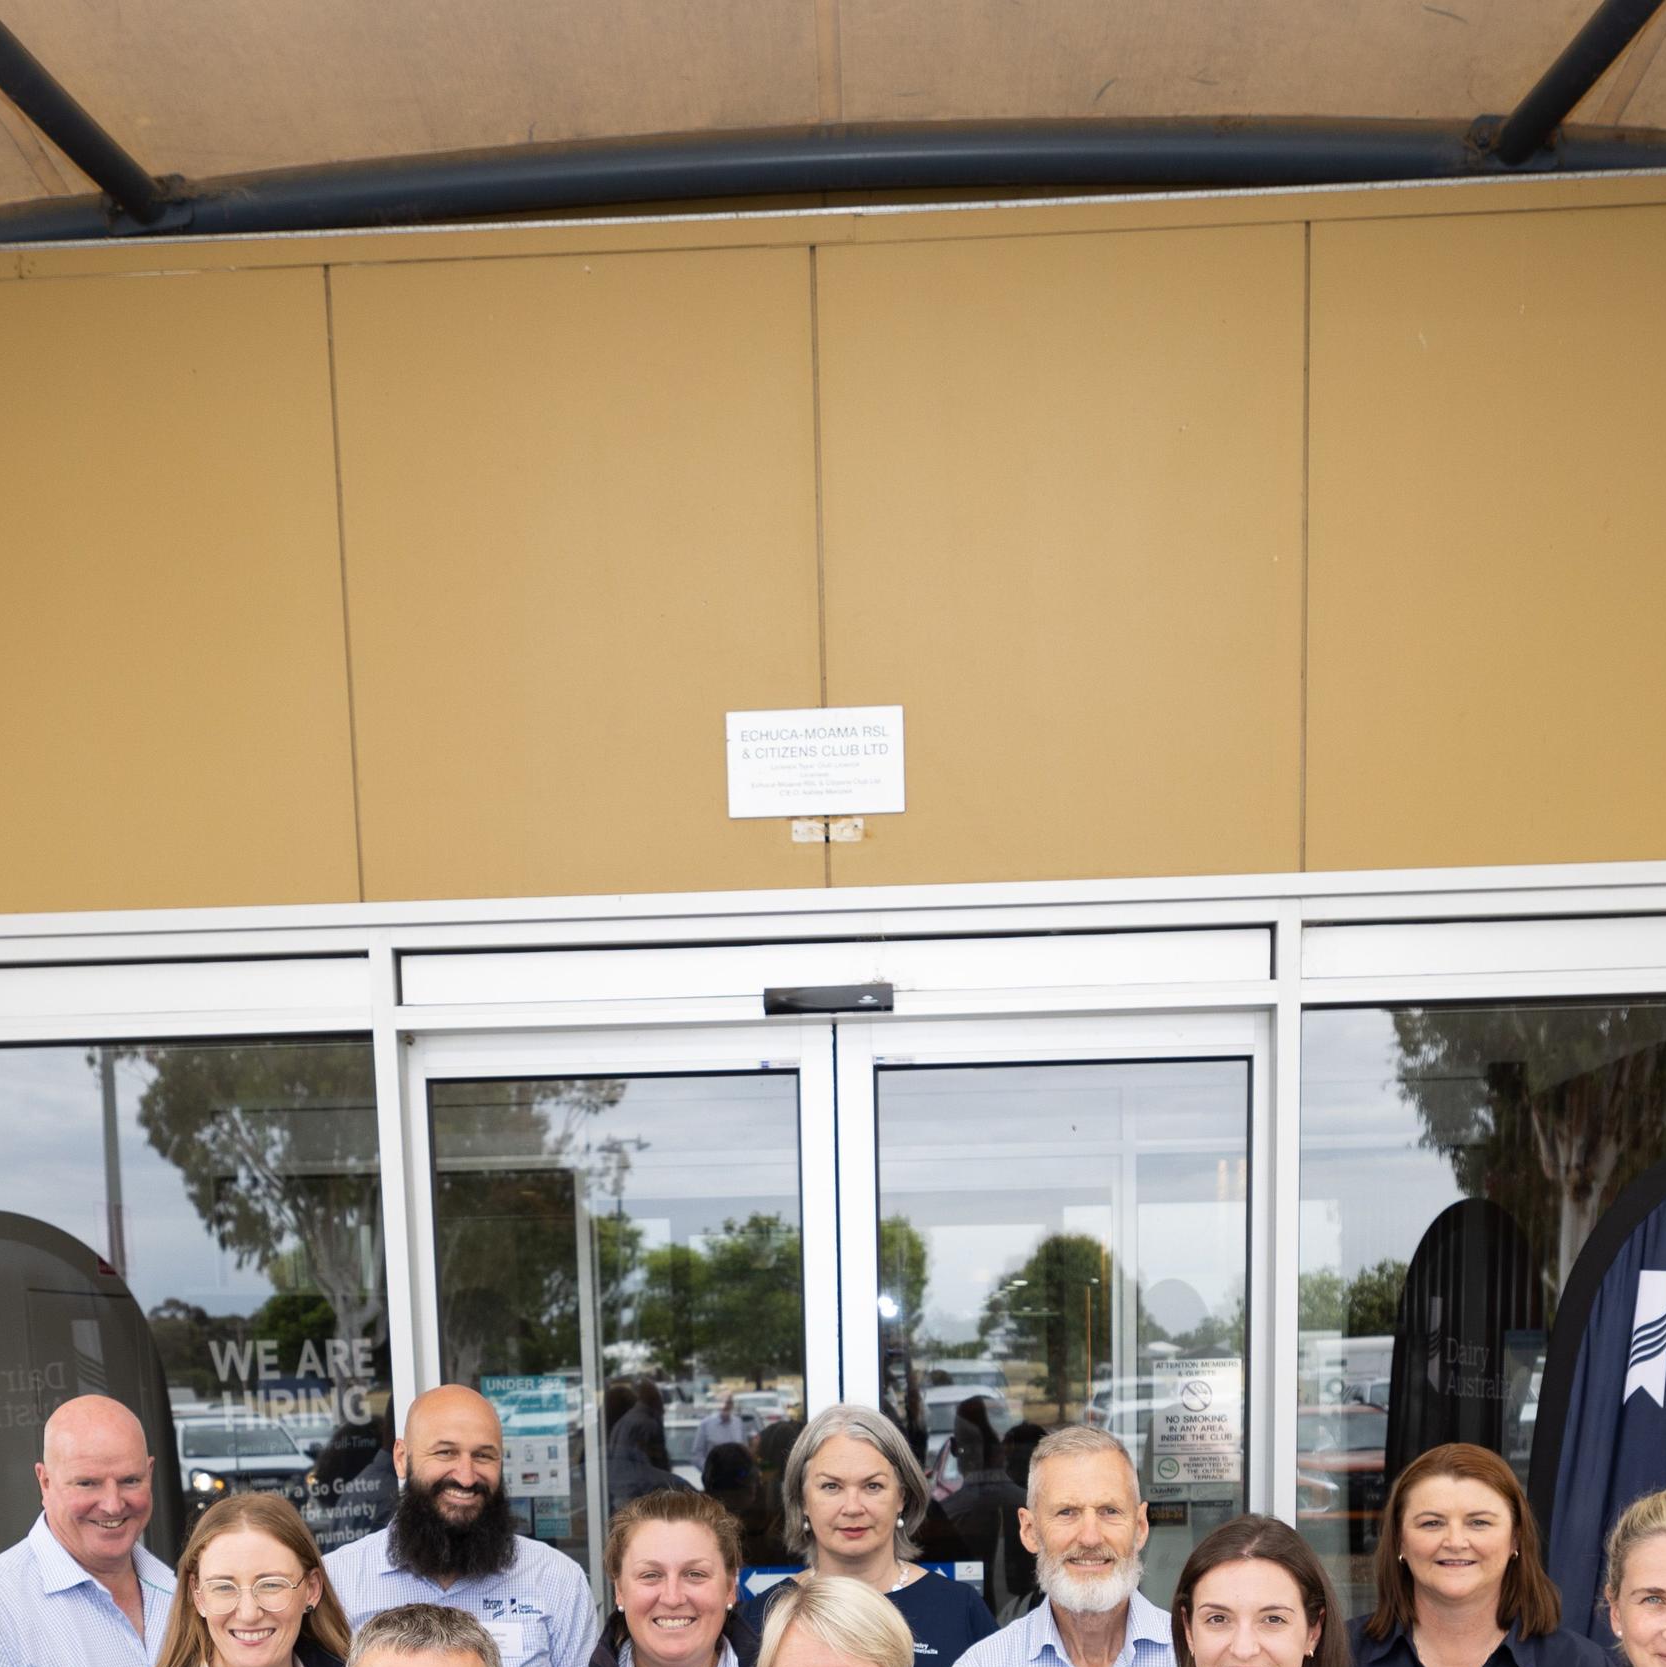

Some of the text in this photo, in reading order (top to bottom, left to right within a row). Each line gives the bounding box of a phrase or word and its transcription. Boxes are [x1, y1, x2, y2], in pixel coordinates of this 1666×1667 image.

[740, 725, 890, 742] ECHUCA-MOAMA RSL
[741, 743, 889, 760] & CITIZENS CLUB LTD
[208, 1338, 376, 1382] WE ARE
[1445, 1337, 1490, 1373] Dairy
[1156, 1360, 1239, 1369] ATTENTION MEMBERS
[486, 1378, 535, 1391] UNDER
[221, 1385, 372, 1432] HIRING
[1165, 1414, 1228, 1424] NO SMOKING
[1169, 1424, 1224, 1433] IN ANY AREA
[1160, 1433, 1233, 1442] INSIDE THE CLUB
[308, 1481, 329, 1496] Go
[333, 1477, 382, 1494] Getter
[299, 1503, 377, 1522] for variety
[315, 1526, 372, 1545] number
